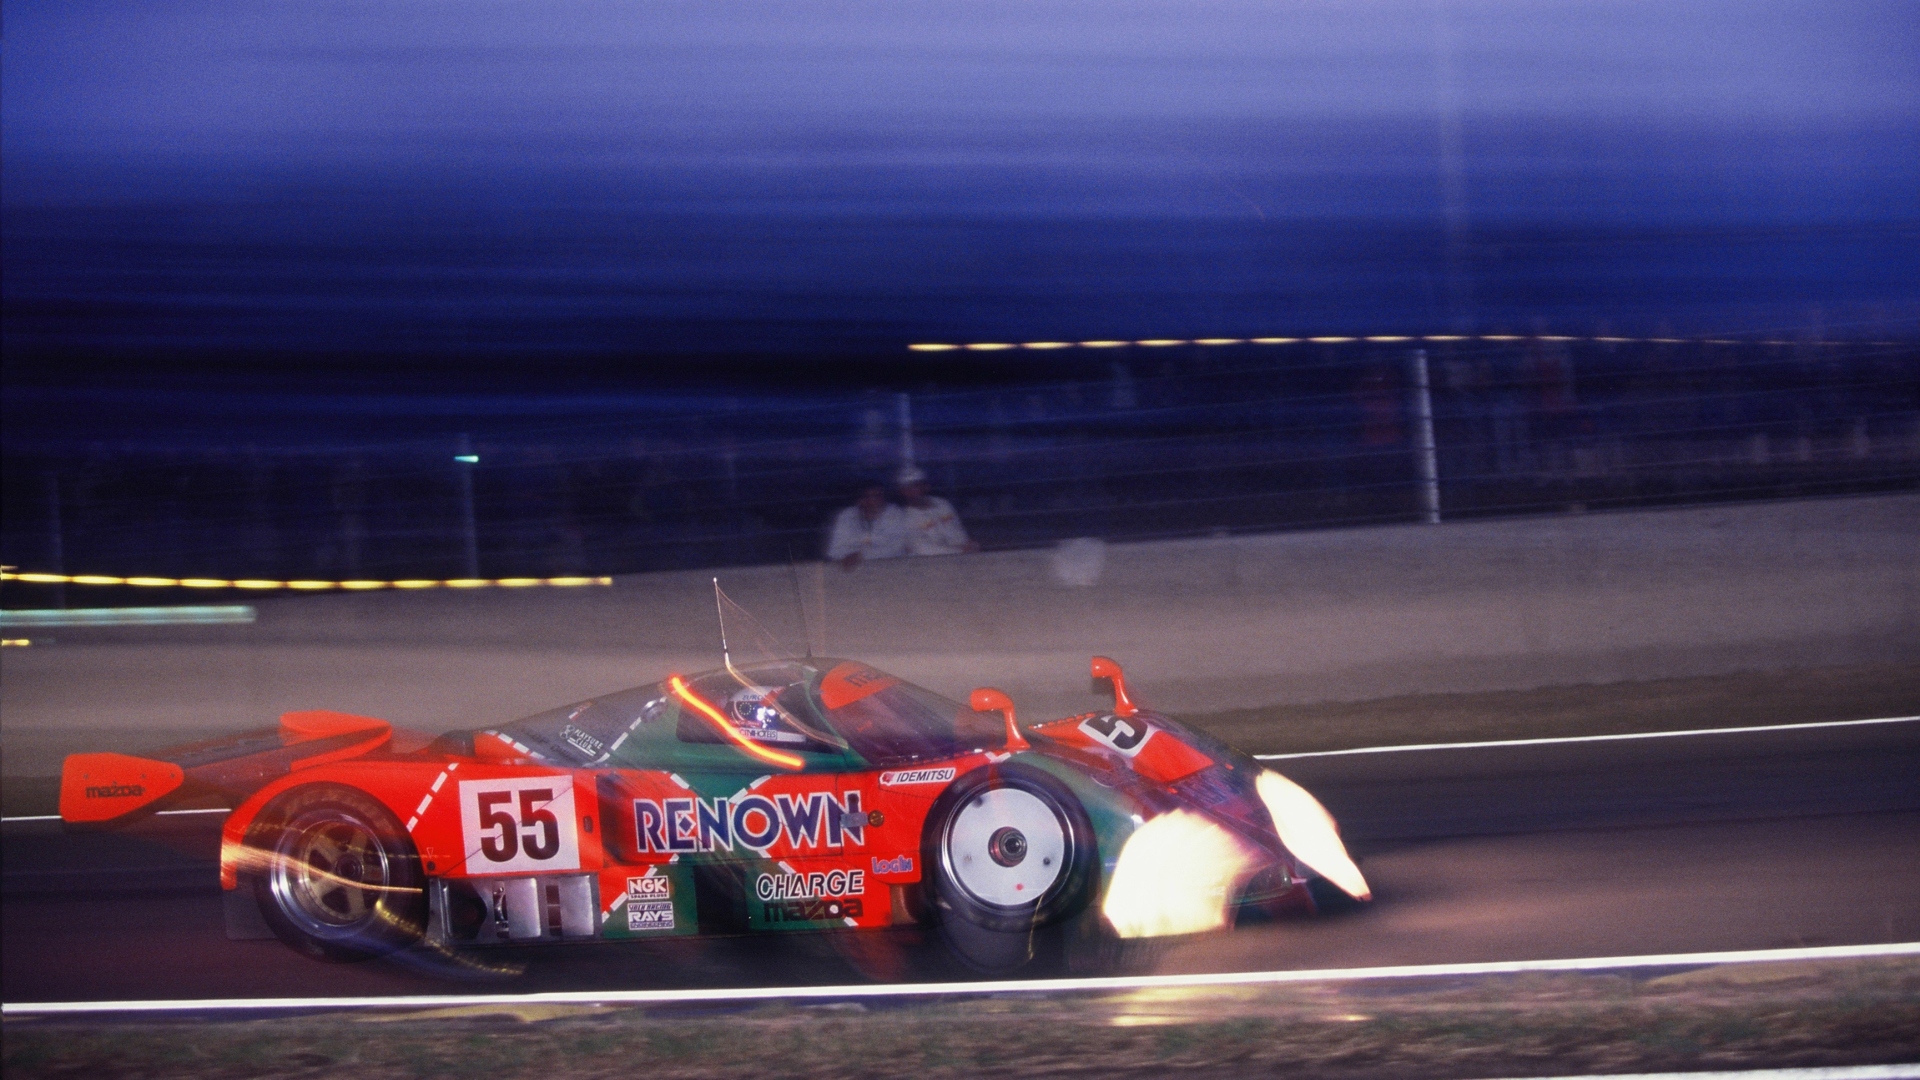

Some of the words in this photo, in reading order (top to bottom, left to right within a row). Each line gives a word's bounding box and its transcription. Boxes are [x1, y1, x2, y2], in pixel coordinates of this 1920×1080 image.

[896, 769, 954, 783] IDEMITSU
[86, 785, 143, 798] mazda
[477, 788, 560, 863] 55
[633, 790, 865, 853] RENOWN
[629, 878, 667, 894] NGK
[756, 869, 864, 901] CHARGE
[628, 910, 674, 922] RAYS
[764, 897, 864, 922] mazda
